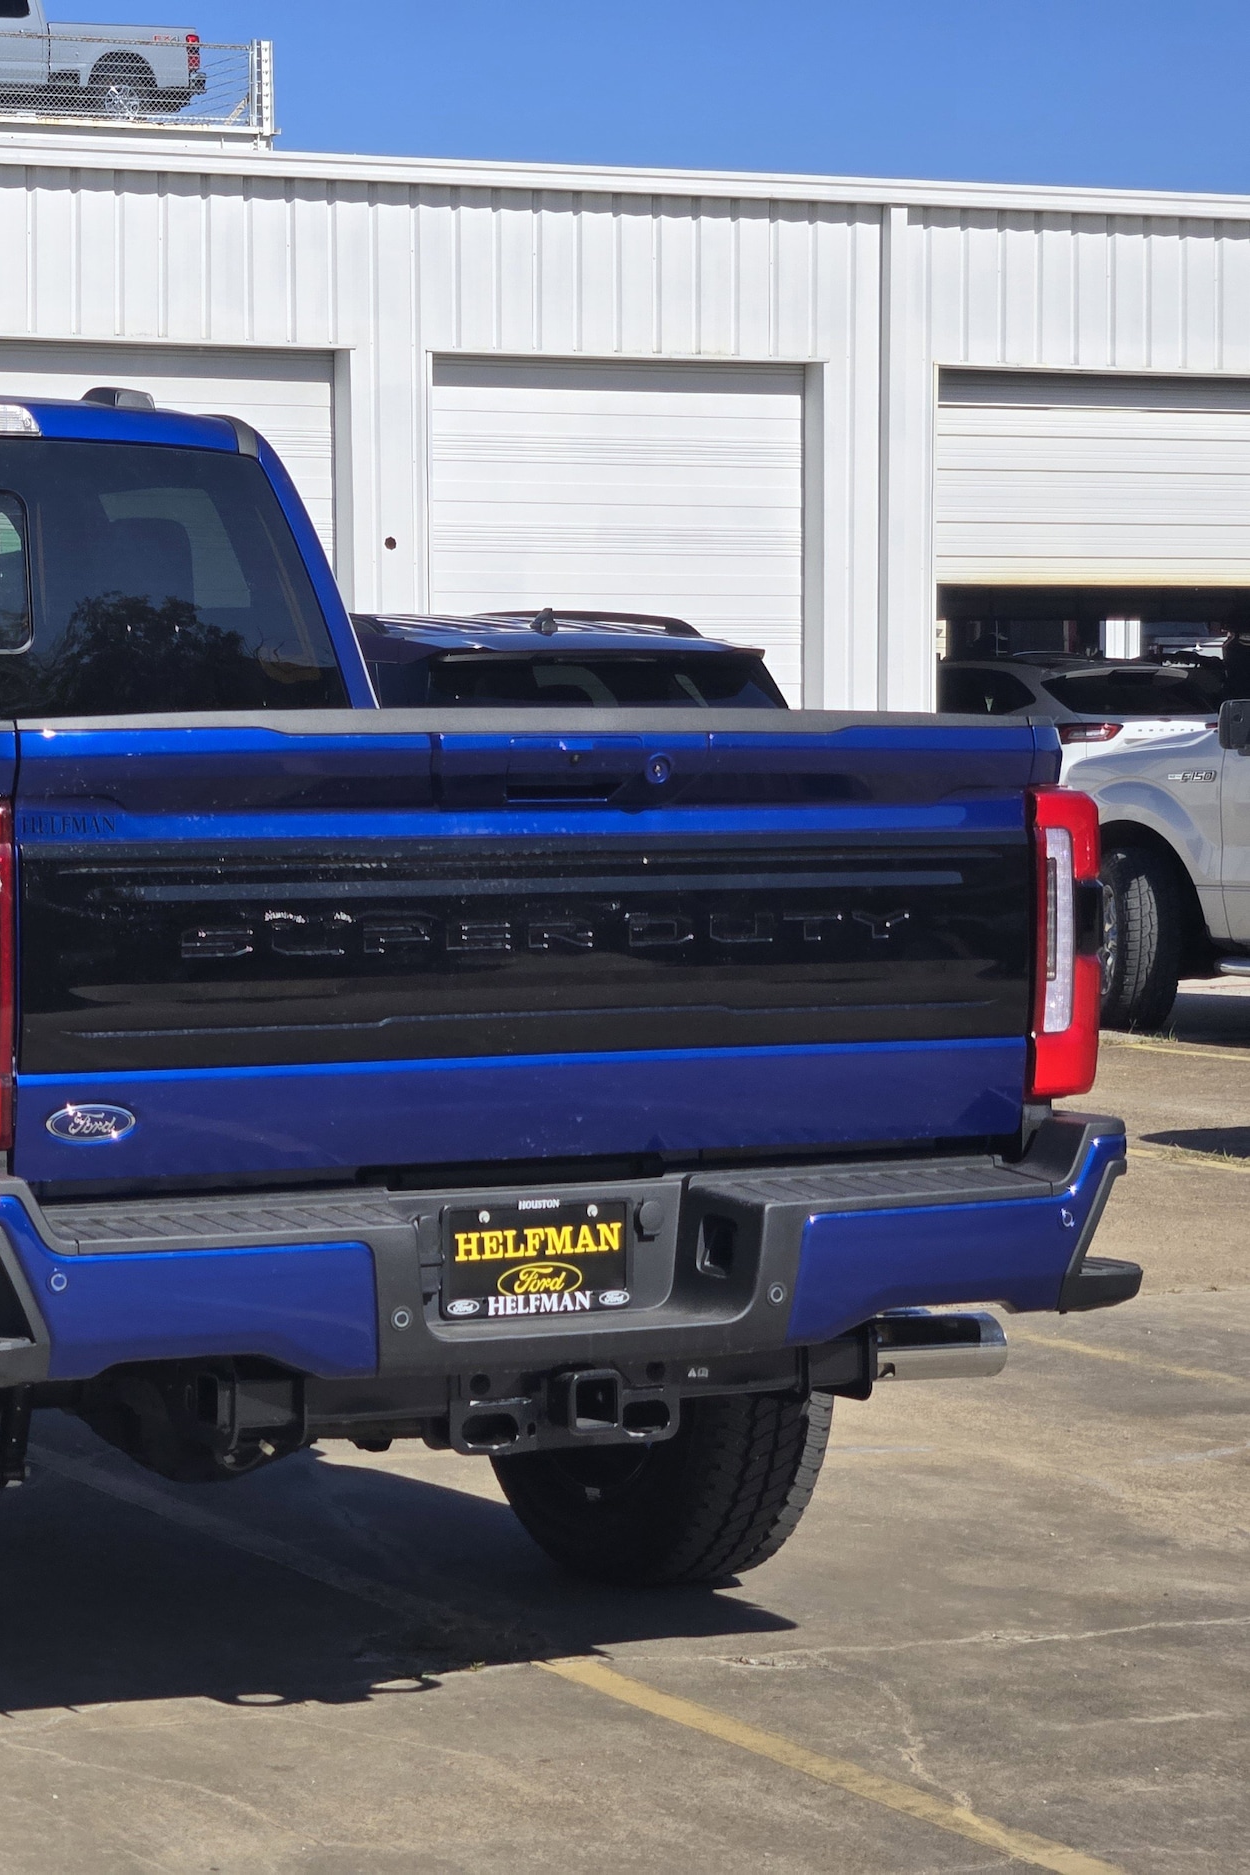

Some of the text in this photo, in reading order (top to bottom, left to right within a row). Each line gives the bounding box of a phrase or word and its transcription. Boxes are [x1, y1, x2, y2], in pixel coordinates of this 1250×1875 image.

[21, 815, 115, 834] HELFMAN
[180, 909, 910, 958] SUPER DUTY
[68, 1112, 116, 1134] Ford
[518, 1199, 560, 1210] HOUSTON
[454, 1222, 622, 1262] HELFMAN
[514, 1267, 566, 1294] Ford
[452, 1291, 626, 1316] Ford HELFMAN Ford
